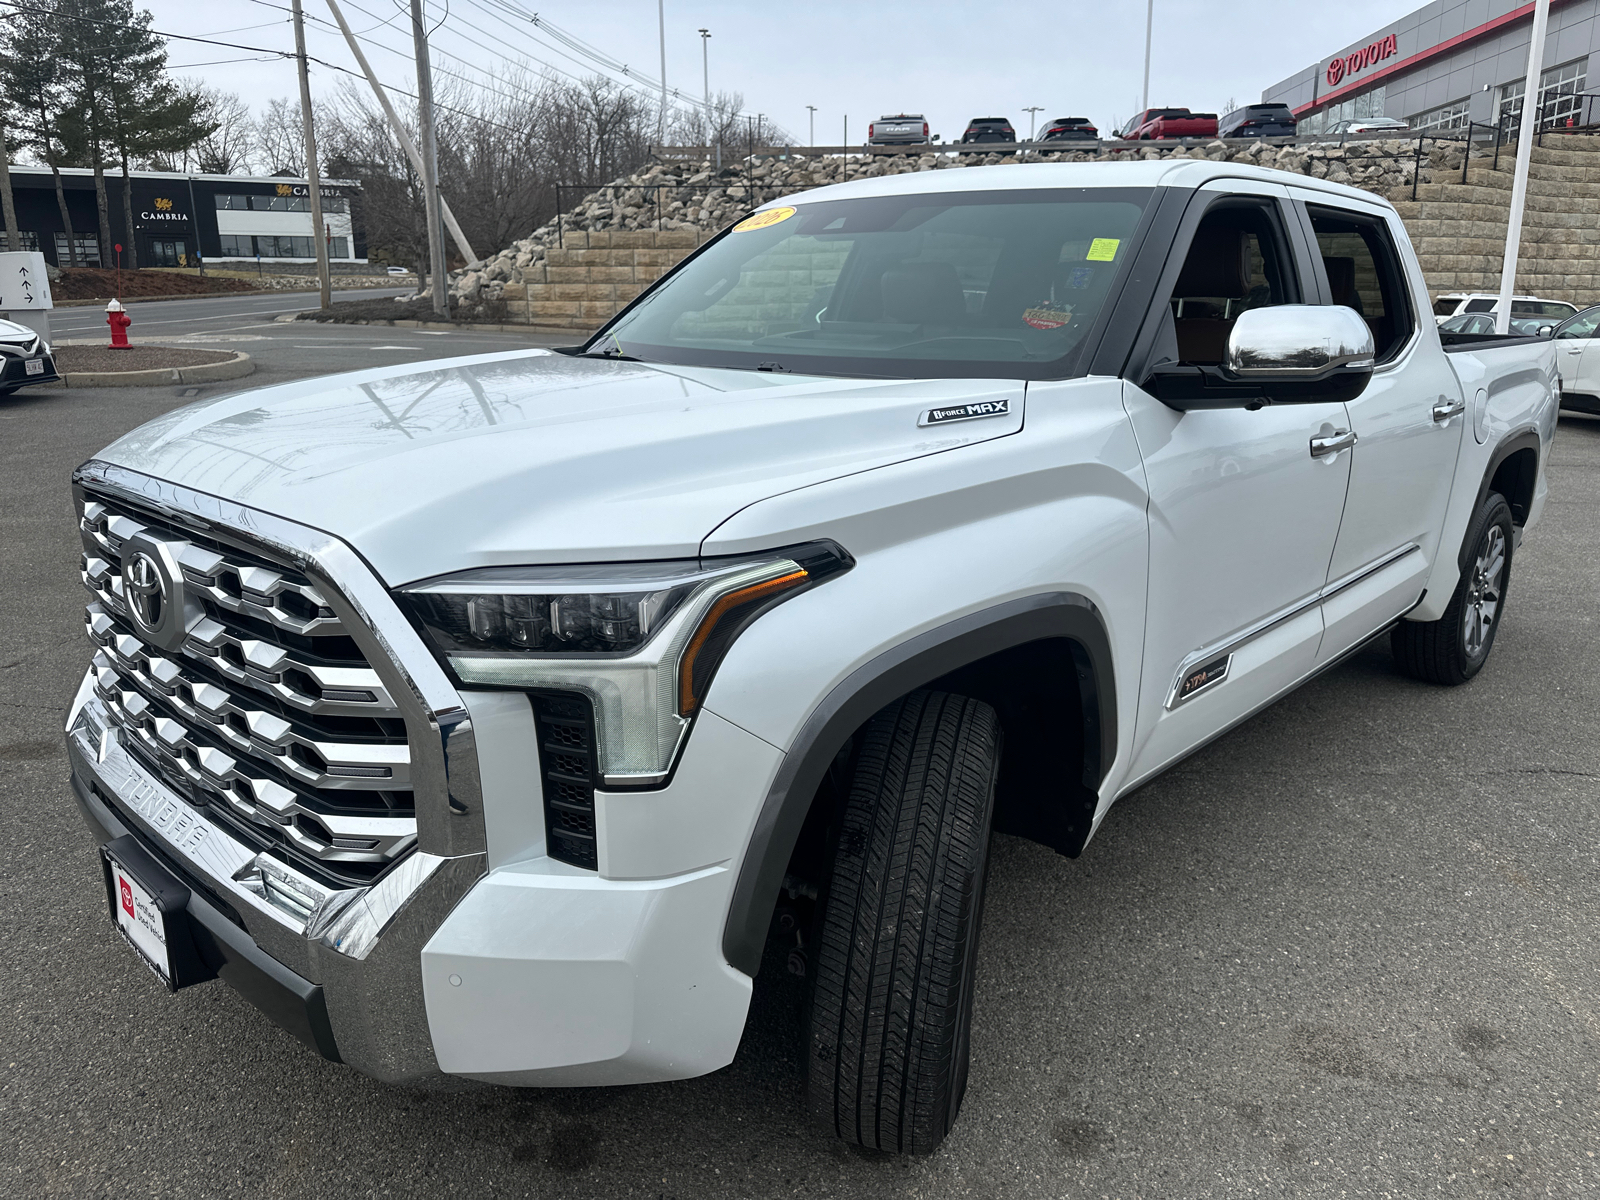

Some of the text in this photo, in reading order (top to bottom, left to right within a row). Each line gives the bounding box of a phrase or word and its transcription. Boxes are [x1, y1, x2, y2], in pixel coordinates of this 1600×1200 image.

[1345, 33, 1397, 76] TOYOTA
[293, 187, 342, 197] CABRIA
[141, 211, 189, 221] CAMBRIA
[966, 401, 1007, 415] MAX
[116, 767, 209, 855] TUNDRA
[134, 896, 156, 924] Certified
